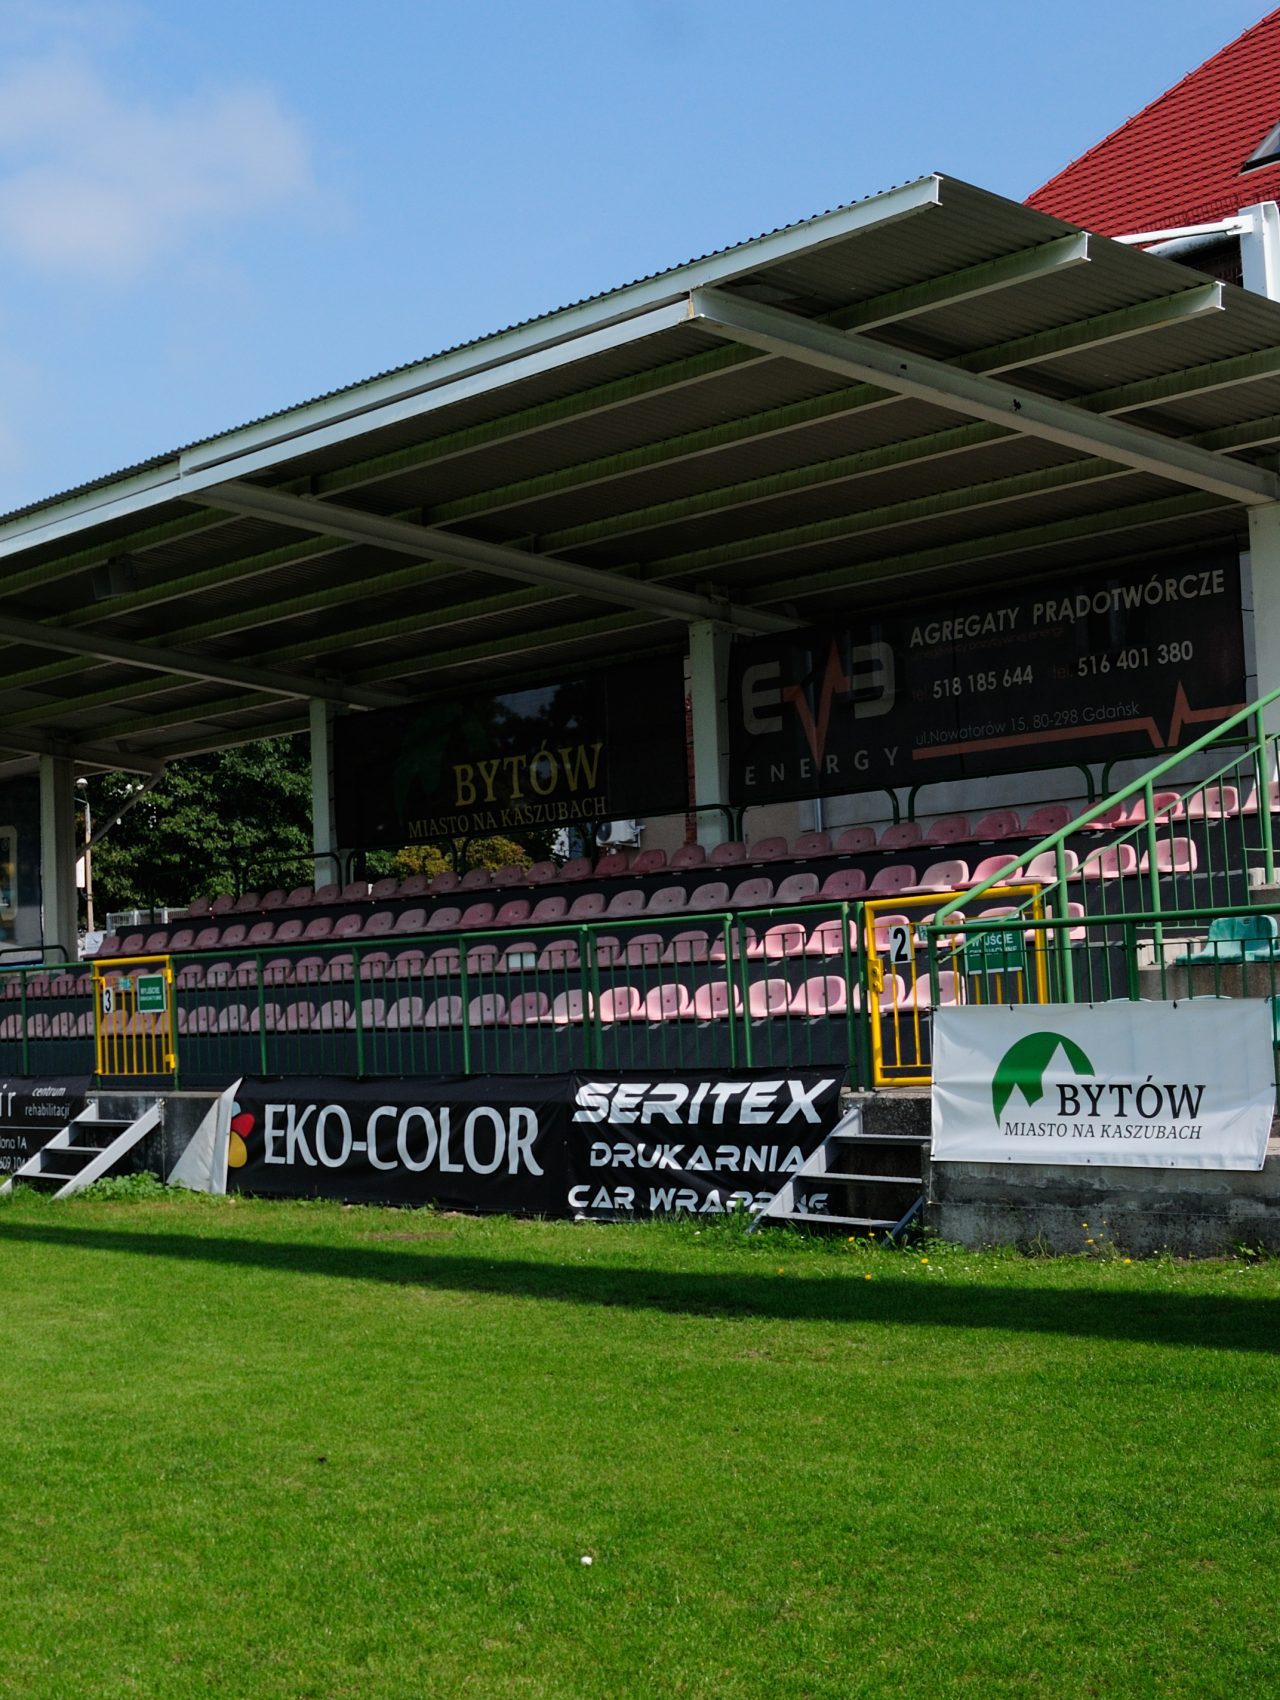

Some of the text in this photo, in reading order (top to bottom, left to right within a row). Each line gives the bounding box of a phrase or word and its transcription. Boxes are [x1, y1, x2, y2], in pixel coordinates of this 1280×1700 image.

[910, 568, 1225, 648] AGREGATY PRĄDOTWÓRCZE
[1077, 653, 1111, 677] 516
[1116, 647, 1148, 671] 401
[1157, 640, 1193, 665] 380
[932, 675, 962, 700] 518
[968, 669, 1000, 694] 185
[1003, 664, 1033, 689] 644
[1010, 716, 1029, 732] 15,
[1033, 708, 1079, 729] 80-298
[1082, 700, 1141, 722] Gdańsk
[452, 739, 604, 808] BYTÓW
[745, 746, 899, 785] ENERGY
[408, 796, 608, 840] MIASTO NA KASZUBACH
[893, 928, 908, 962] 2
[105, 989, 112, 1012] 3
[32, 1086, 66, 1097] centrum
[572, 1079, 836, 1125] SERITEX
[1056, 1075, 1206, 1120] BYTÓW
[25, 1103, 70, 1119] rehabilitacji
[18, 1136, 27, 1149] 1A
[264, 1104, 544, 1176] EKO-COLOR
[1004, 1122, 1202, 1140] MIASTO NA KASZUBACH
[590, 1141, 805, 1173] DRUKARNIA
[568, 1184, 829, 1214] CAR WRAPPG
